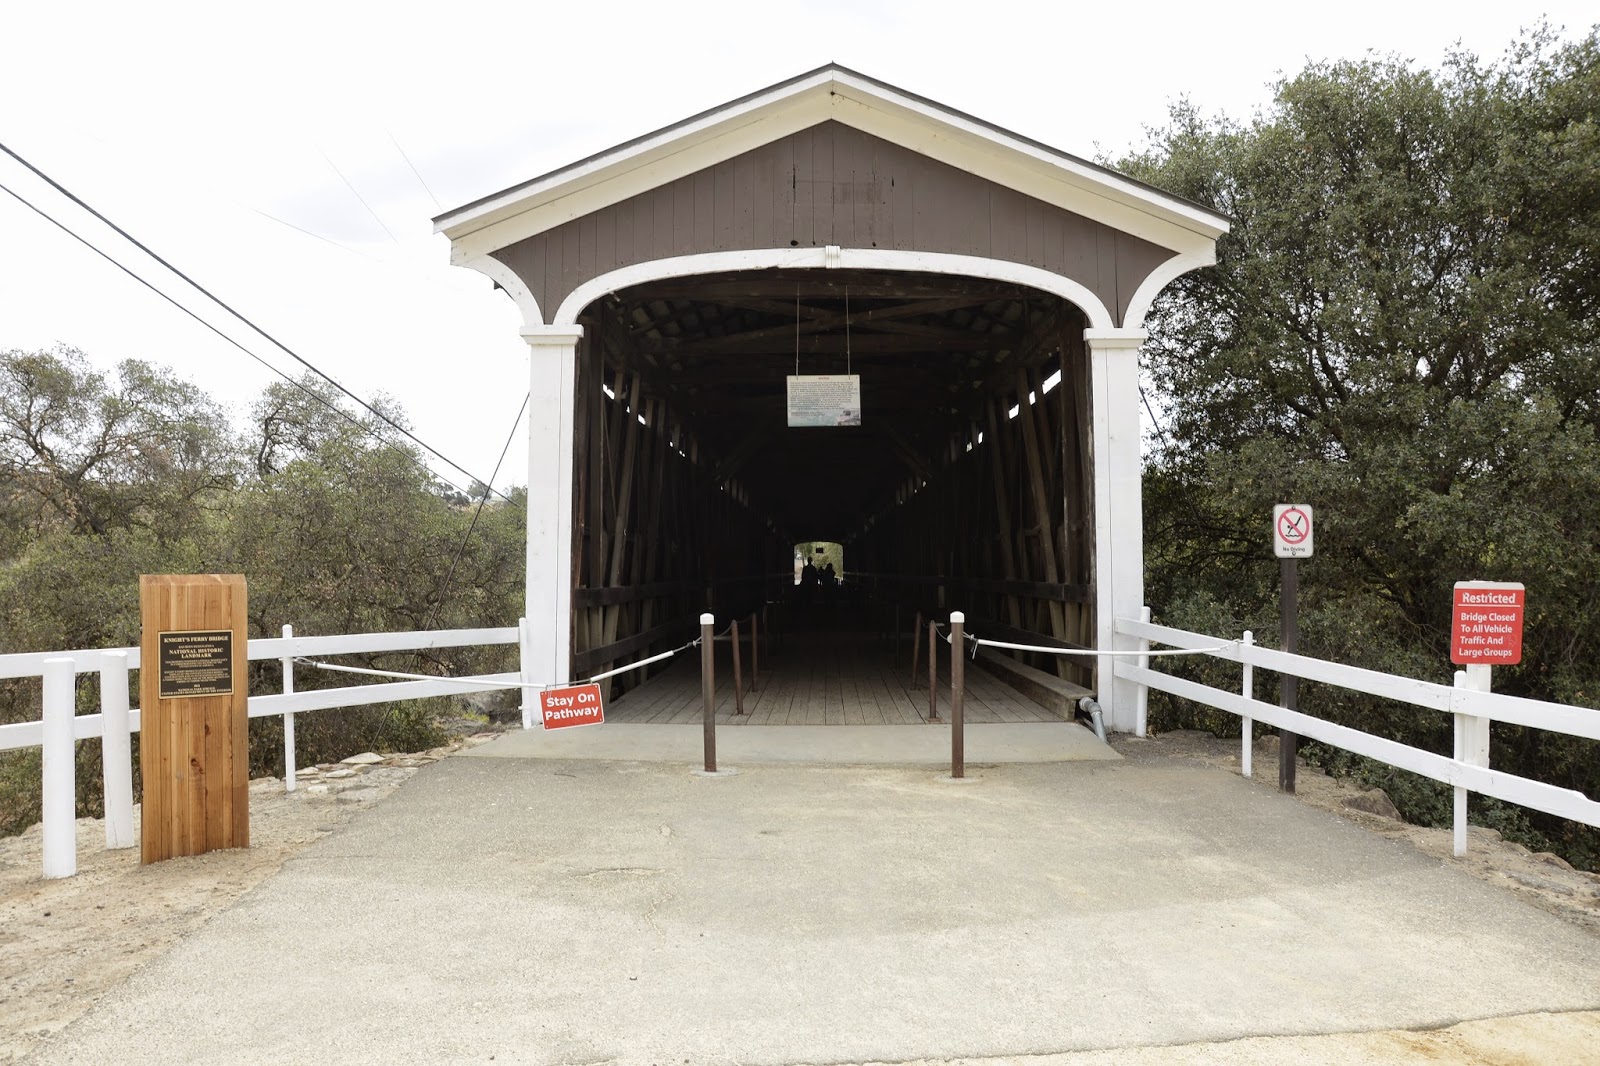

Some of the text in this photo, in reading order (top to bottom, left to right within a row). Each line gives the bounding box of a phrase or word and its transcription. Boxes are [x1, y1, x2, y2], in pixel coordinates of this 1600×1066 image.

[1462, 592, 1516, 604] Restricted
[1460, 612, 1516, 623] Bridge Closed
[1460, 624, 1512, 633] To All Vehicle
[1460, 636, 1504, 644] Traffic And
[1458, 648, 1512, 658] Large Groups
[546, 693, 595, 707] Stay On
[545, 706, 599, 720] Pathway
